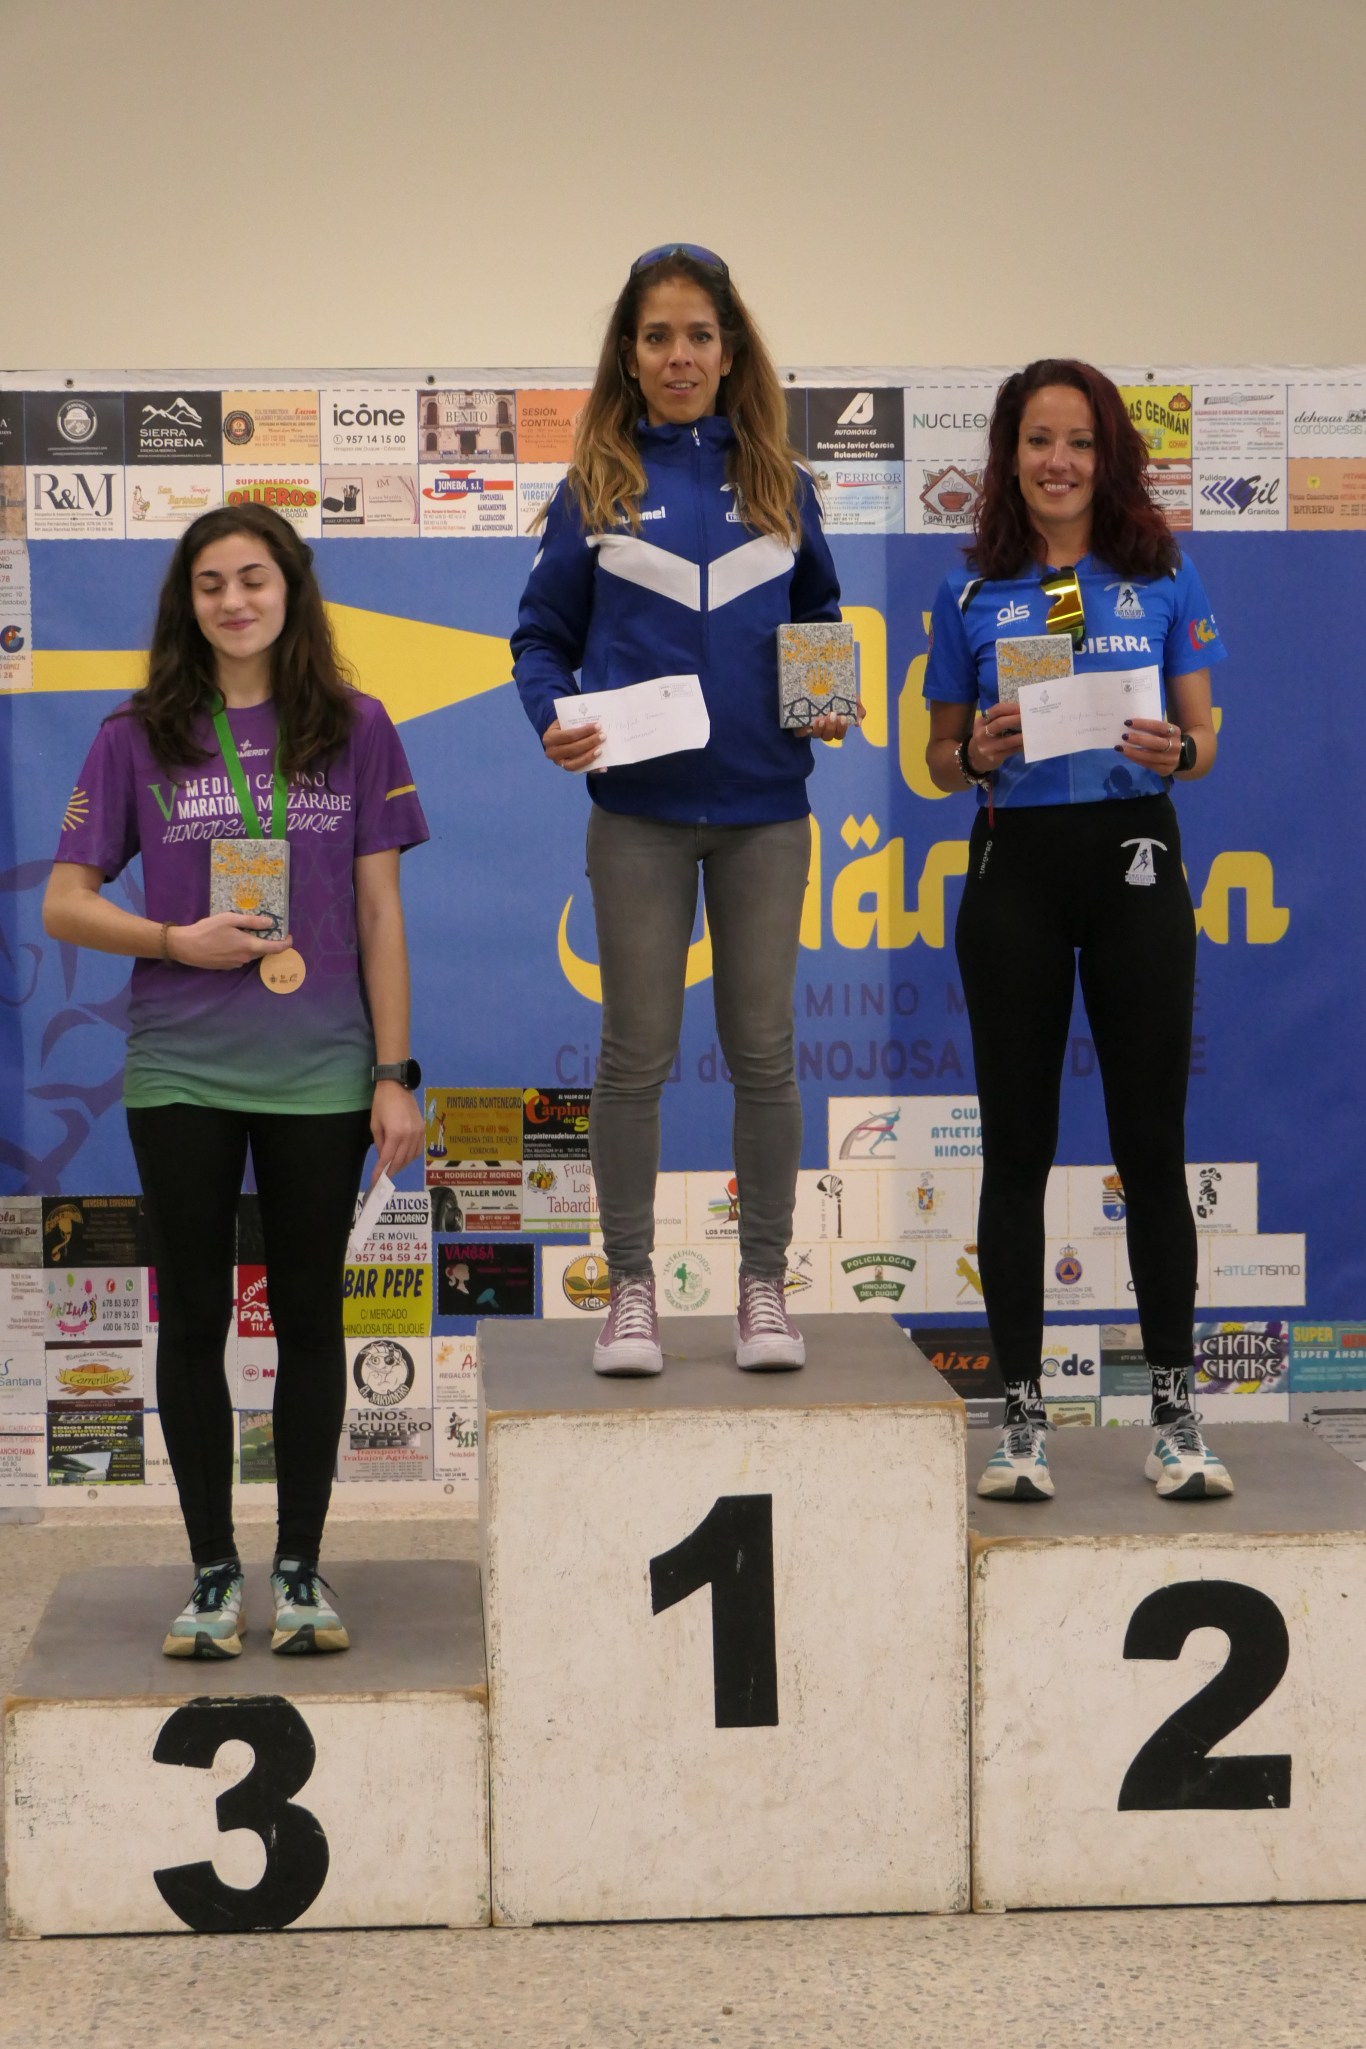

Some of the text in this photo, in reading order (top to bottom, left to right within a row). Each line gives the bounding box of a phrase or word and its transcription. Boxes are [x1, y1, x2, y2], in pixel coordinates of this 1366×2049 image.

[474, 393, 496, 404] BAR
[333, 403, 405, 426] icône
[446, 411, 488, 423] BENITO
[1146, 400, 1189, 435] GERMÁN
[1294, 411, 1343, 423] dehesas
[140, 428, 187, 437] SIERRA
[1293, 421, 1363, 435] cordobesas
[140, 438, 204, 448] MORENA
[346, 435, 406, 443] 957 14 15 00
[836, 472, 902, 484] FERRICOR
[228, 486, 317, 507] OLLEROS
[523, 490, 550, 501] VIRGEN
[928, 515, 943, 524] BAR
[996, 601, 1031, 620] als
[147, 784, 178, 822] V
[257, 789, 351, 812] MZÁRABE
[162, 813, 342, 844] HINOJOSA DUQUE
[447, 1096, 522, 1109] PINTURAS MONTENEGRO
[563, 1116, 575, 1124] del
[951, 1108, 980, 1120] CLU
[496, 1136, 518, 1146] DUQUE
[444, 1171, 488, 1179] RODRÍGUEZ
[460, 1188, 517, 1197] TALLER MÓVIL
[573, 1180, 591, 1193] Los
[394, 1214, 427, 1224] MORENO
[388, 1230, 419, 1241] MÓVIL
[379, 1243, 427, 1251] 46 82 44
[355, 1254, 427, 1262] 957 94 59 47
[883, 1256, 912, 1268] LOCAL
[343, 1268, 425, 1299] BAR PEPE
[132, 1299, 139, 1307] 27
[102, 1311, 113, 1319] 617
[123, 1311, 131, 1319] 36
[132, 1311, 139, 1319] 21
[370, 1309, 408, 1319] MERCADO
[123, 1323, 131, 1331] 75
[132, 1323, 140, 1331] 03
[343, 1323, 425, 1335] HINOJOSA DEL DUQUE
[1293, 1326, 1333, 1342] SUPER
[1202, 1334, 1281, 1356] CHAKE
[1293, 1350, 1330, 1358] SUPER
[929, 1352, 991, 1370] Aixa
[1202, 1358, 1282, 1380] CHAKE
[357, 1411, 413, 1421] HNOS.
[341, 1422, 432, 1433] ESCUDERO
[356, 1448, 408, 1456] Transporte
[650, 1495, 778, 1728] 1
[1118, 1580, 1291, 1811] 2
[154, 1696, 330, 1936] 3
